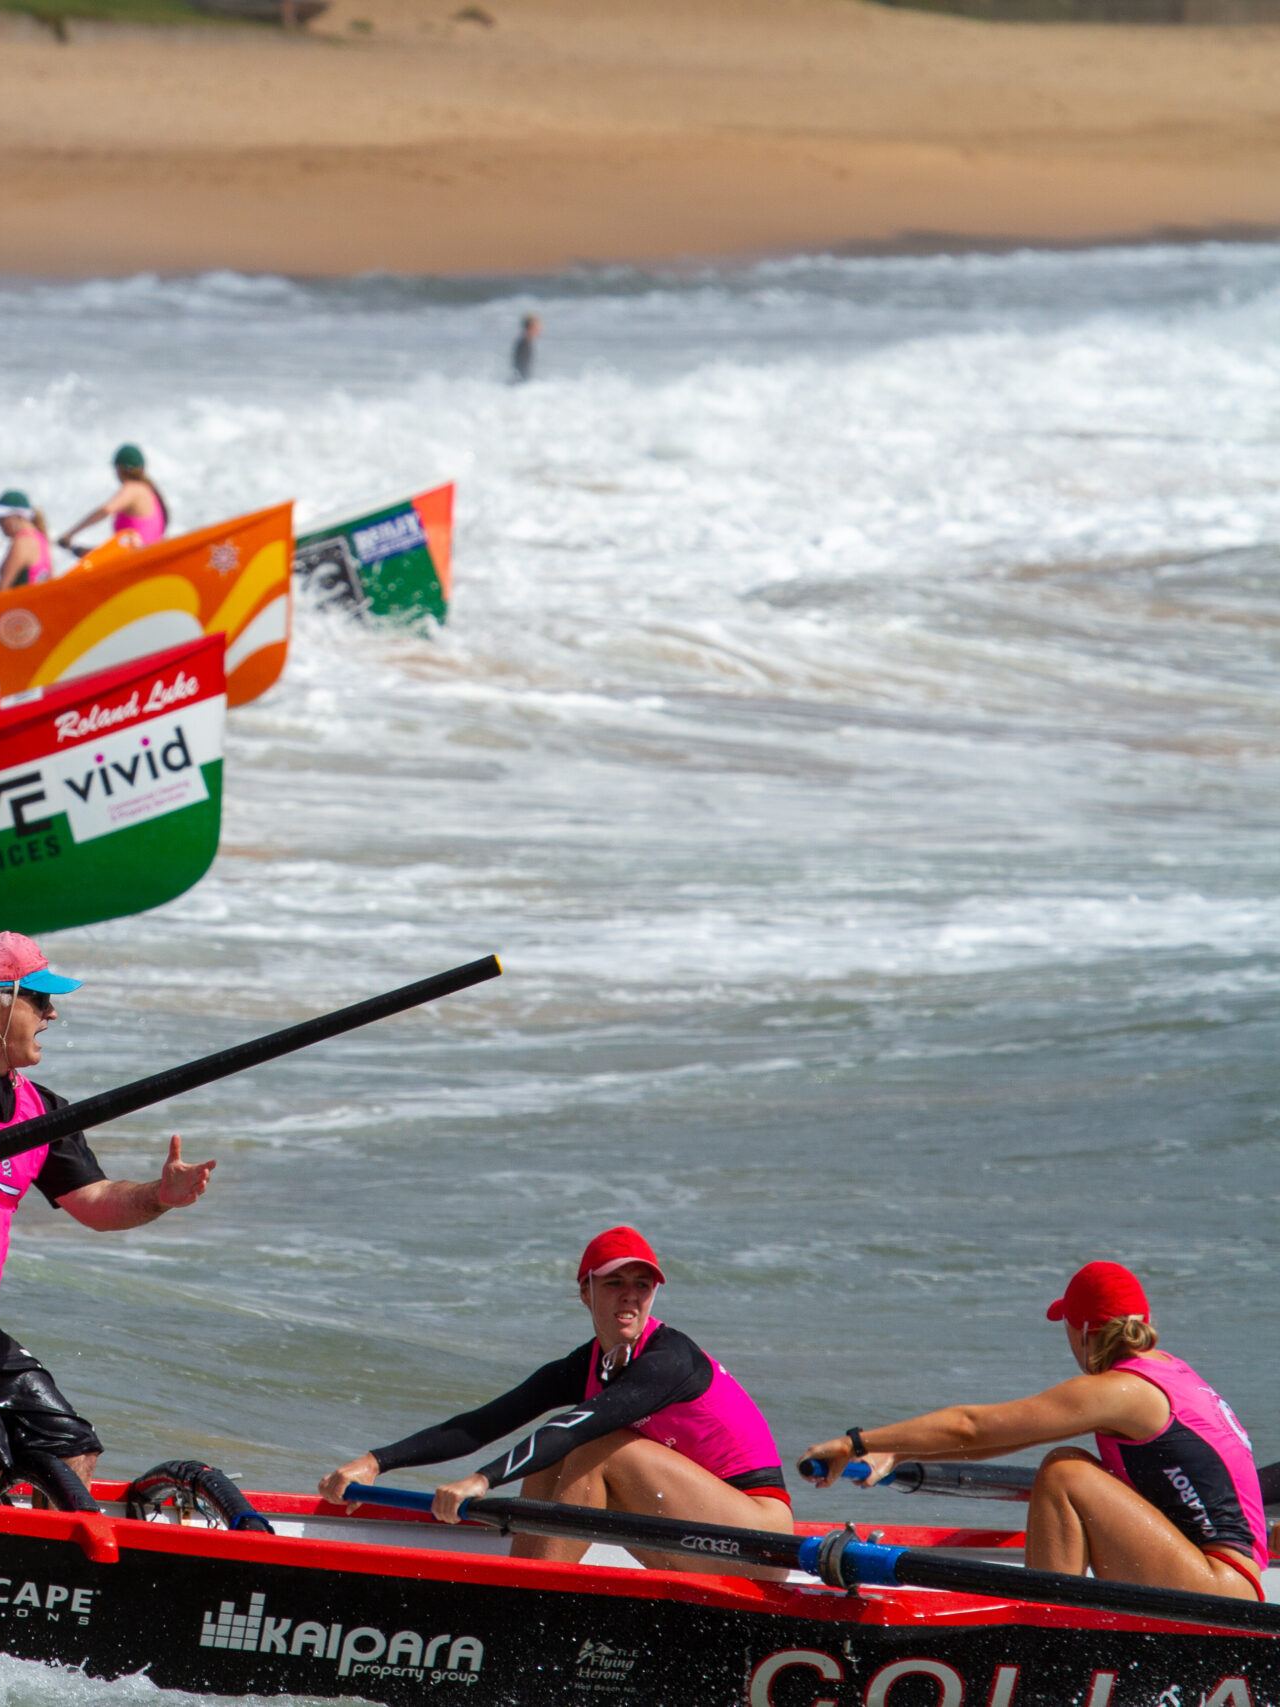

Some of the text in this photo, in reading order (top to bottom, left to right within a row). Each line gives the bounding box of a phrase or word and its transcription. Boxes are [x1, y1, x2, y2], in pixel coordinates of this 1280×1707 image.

[54, 670, 200, 743] Roland Luke
[64, 724, 193, 803] vivid
[590, 1655, 635, 1671] Flying
[431, 1669, 480, 1688] group
[578, 1666, 627, 1681] Herons
